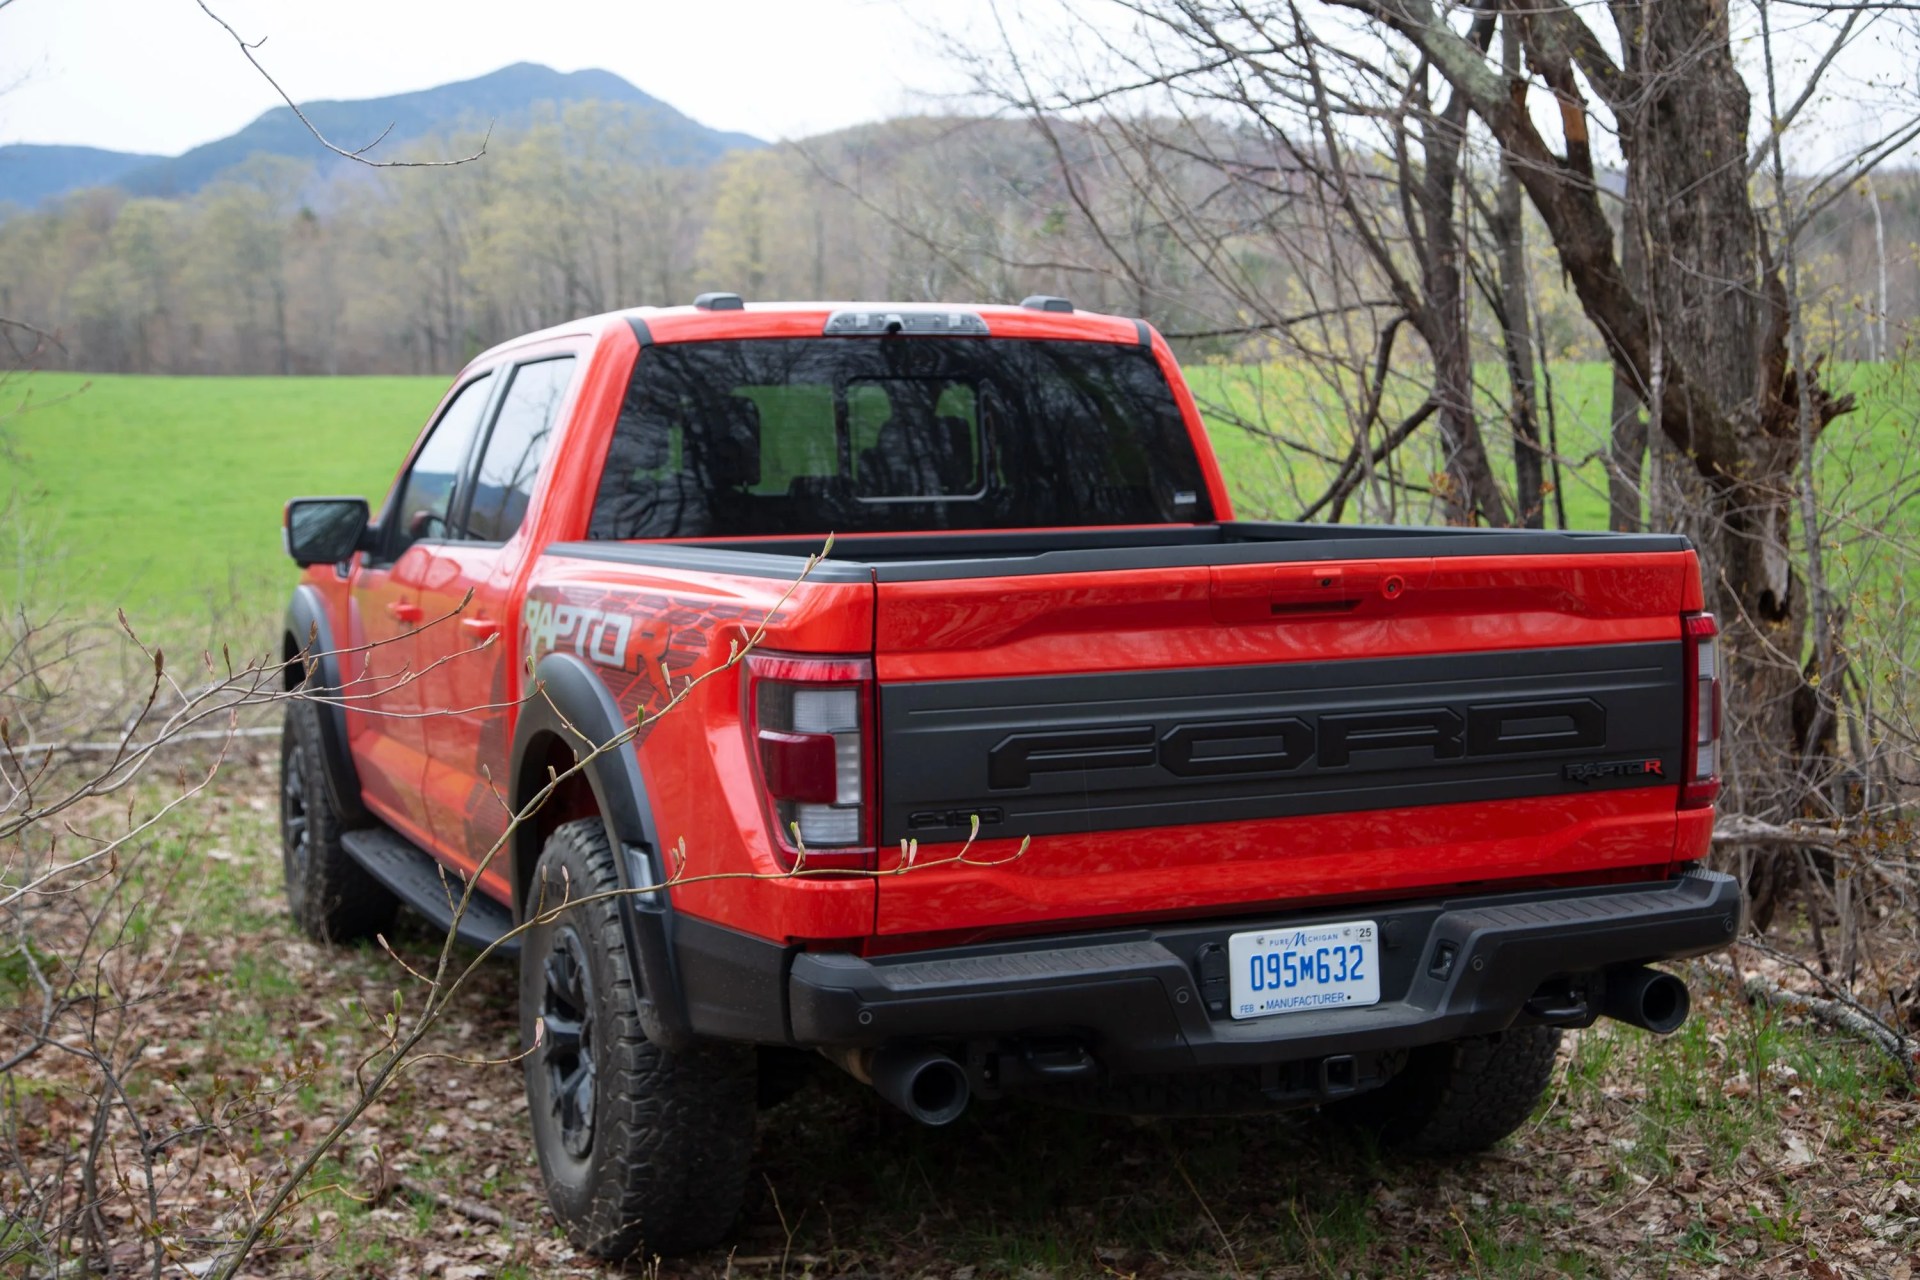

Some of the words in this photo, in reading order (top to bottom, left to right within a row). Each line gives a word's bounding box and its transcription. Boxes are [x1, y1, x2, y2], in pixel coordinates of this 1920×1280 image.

[988, 696, 1607, 790] FORD
[1563, 758, 1664, 783] RAPTOR
[1269, 938, 1289, 947] PURE
[1287, 932, 1338, 949] MICHIGAN
[1359, 928, 1372, 938] 25
[1250, 945, 1364, 991] 095M632
[1240, 1005, 1254, 1014] FEB
[1266, 992, 1344, 1010] MANUFACTURER
